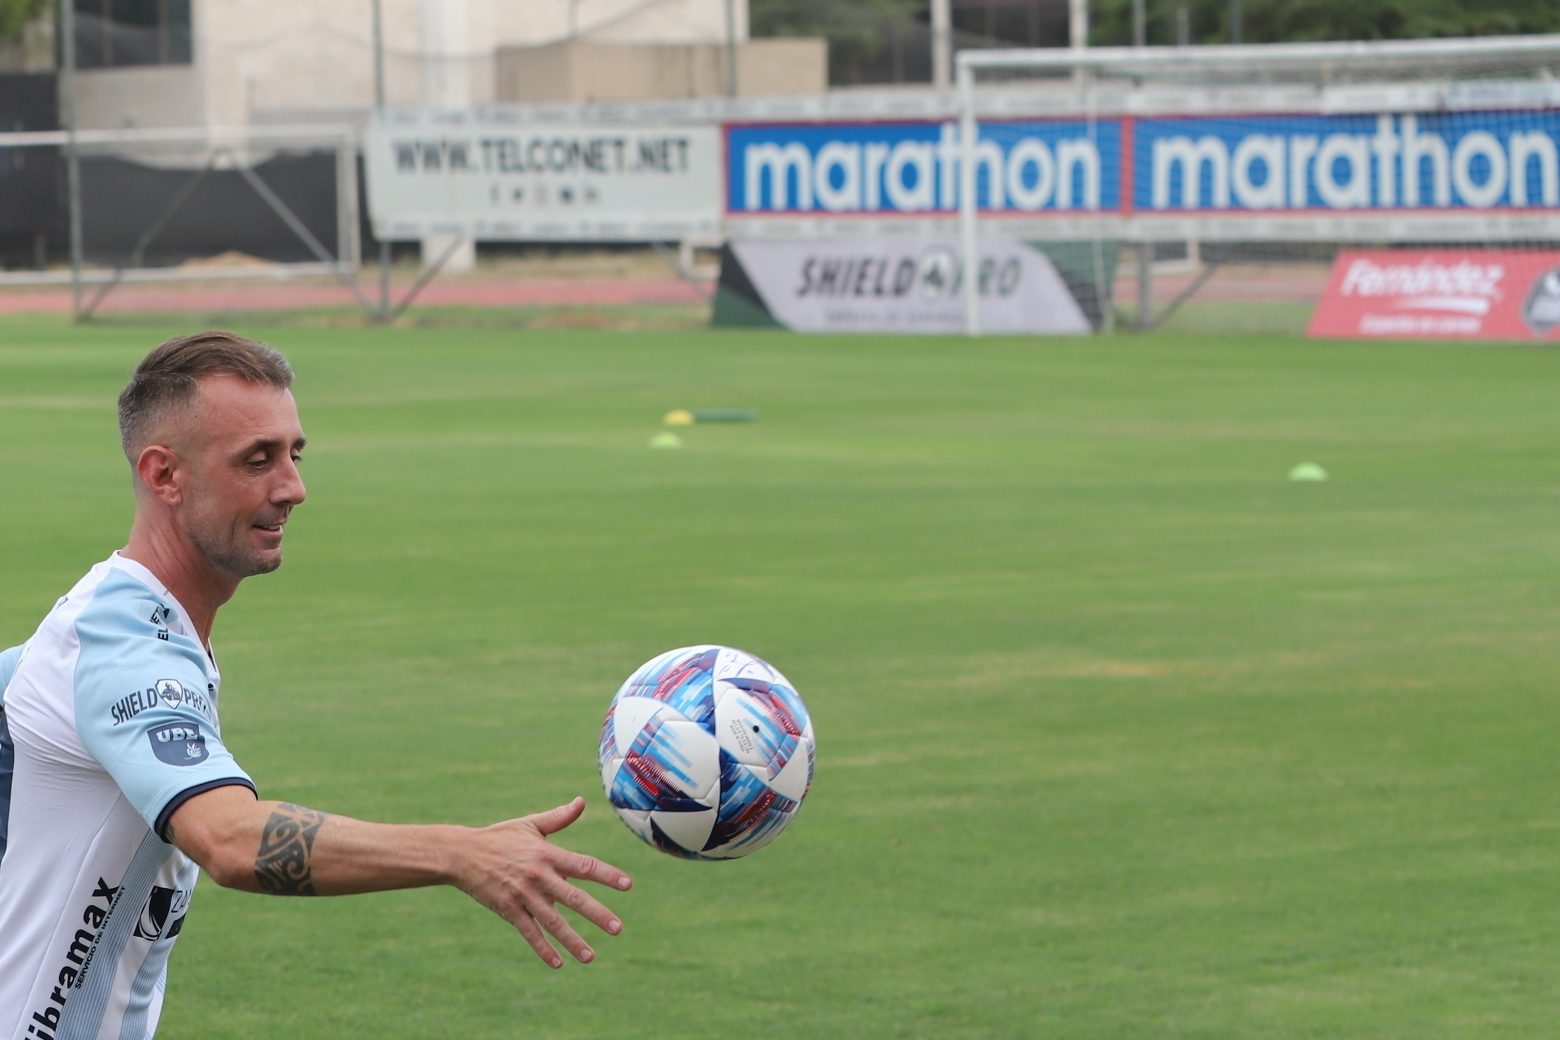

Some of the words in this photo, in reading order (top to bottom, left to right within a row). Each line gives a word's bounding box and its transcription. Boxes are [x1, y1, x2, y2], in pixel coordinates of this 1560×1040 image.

[392, 136, 691, 175] WWW.TELCONET.NET
[744, 121, 1101, 212] marathon
[1152, 113, 1560, 211] marathon
[797, 256, 917, 298] SHIELD
[111, 688, 158, 727] SHIELD
[75, 946, 97, 990] SERVICIO
[96, 931, 103, 945] DE
[101, 886, 126, 931] INTERNET
